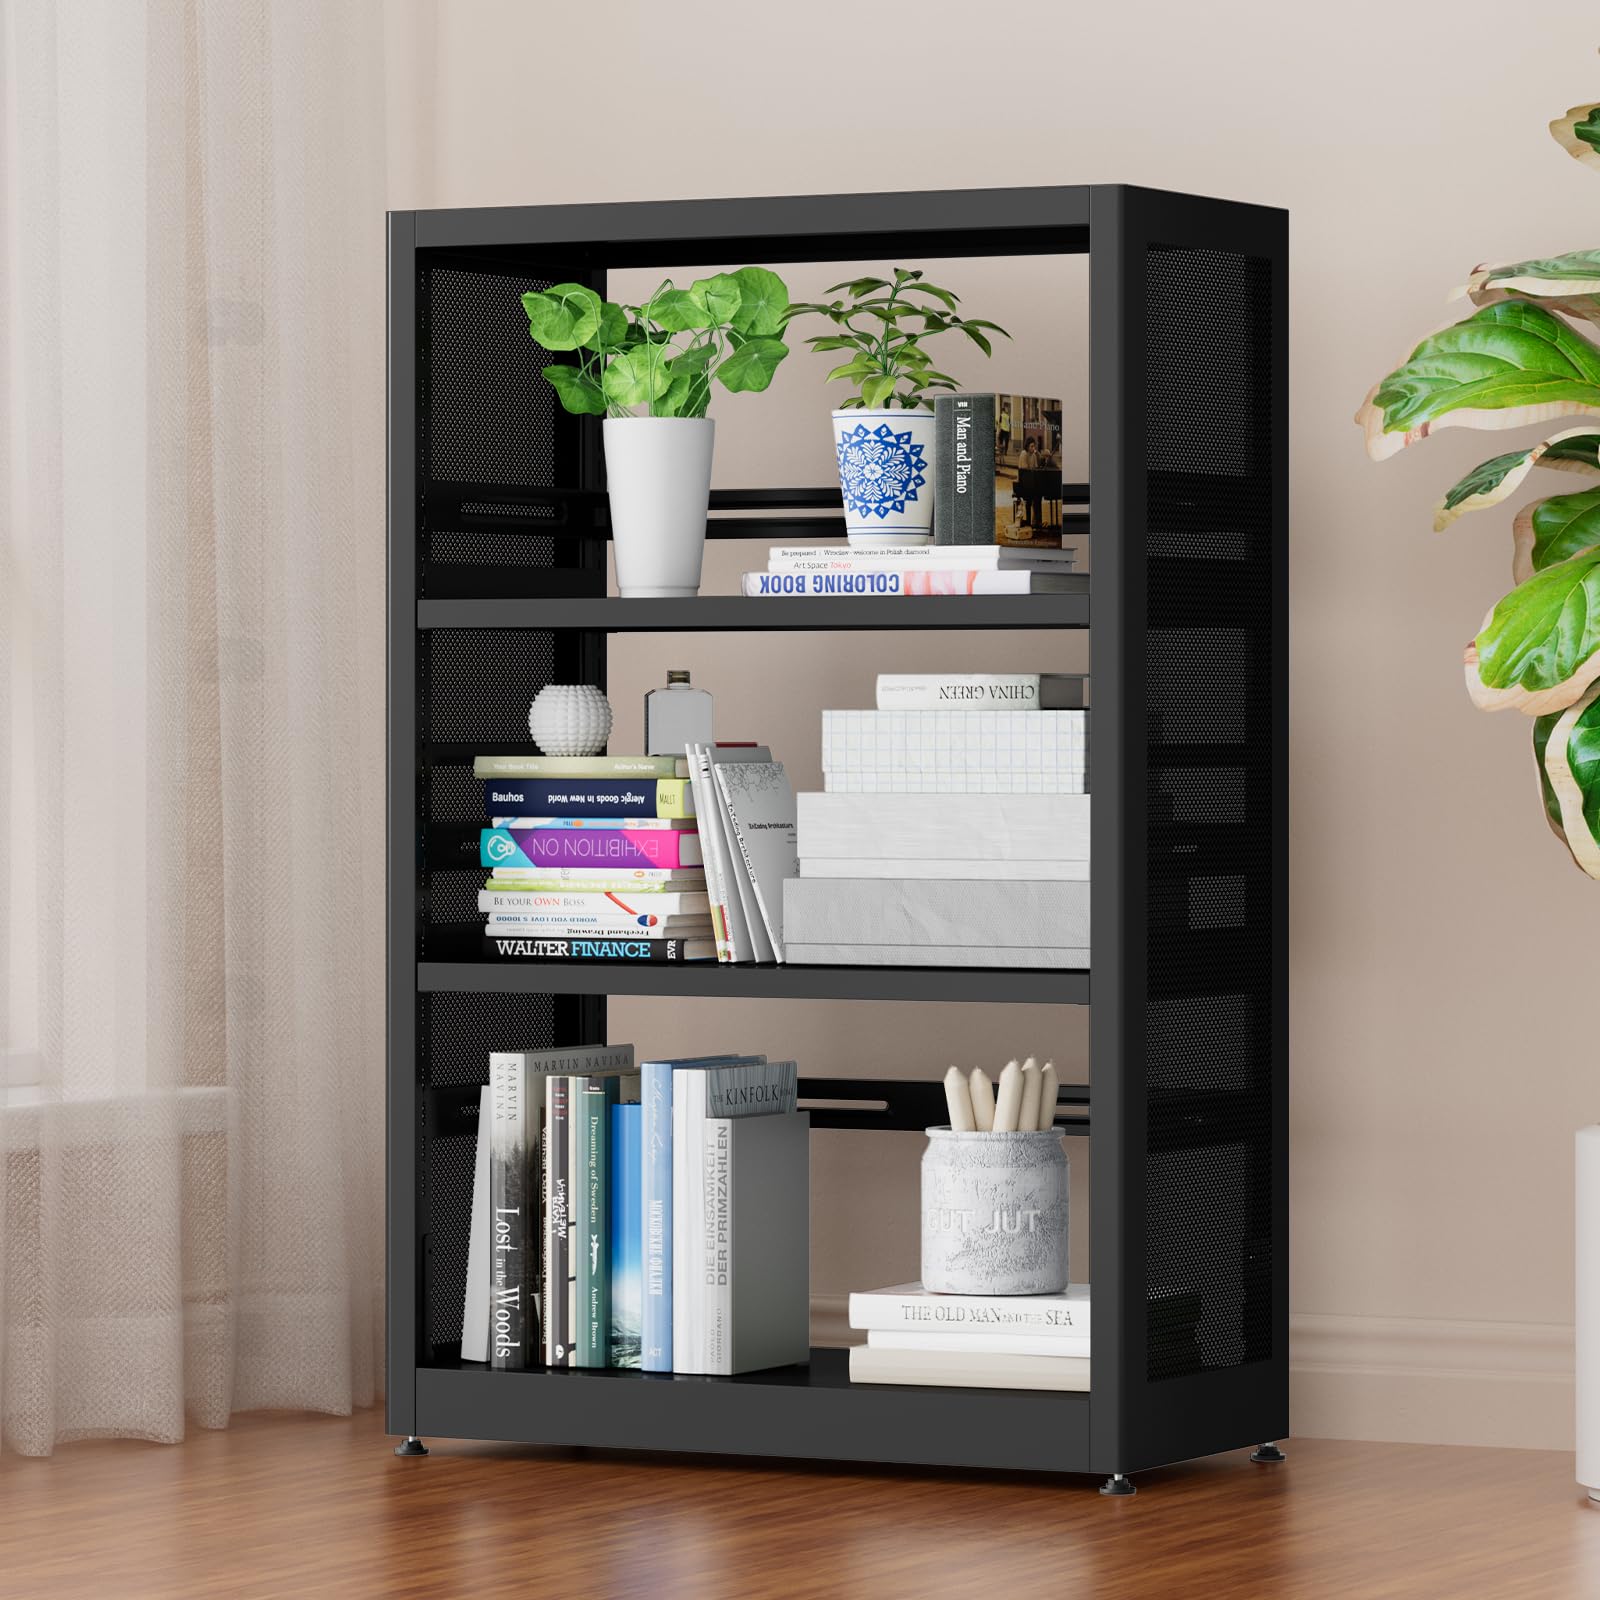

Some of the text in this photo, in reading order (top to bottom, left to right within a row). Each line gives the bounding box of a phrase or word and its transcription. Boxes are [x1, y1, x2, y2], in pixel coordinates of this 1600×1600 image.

[956, 416, 972, 494] Man and Piano
[807, 562, 828, 570] Space
[830, 562, 852, 570] Tokyo
[759, 574, 900, 594] COLORING BOOK
[938, 685, 985, 700] GREEN
[988, 685, 1036, 700] CHINA
[492, 792, 525, 802] Bauhos
[547, 795, 568, 804] World
[570, 795, 585, 804] New
[596, 795, 619, 804] Goods
[620, 792, 645, 804] Alergic
[532, 837, 659, 858] EXHIBITION ON
[507, 897, 532, 906] YOUR
[533, 897, 560, 906] OWN
[567, 928, 604, 936] Drawing
[607, 928, 650, 936] Freehand
[495, 940, 651, 958] WALTER FINANCE
[666, 940, 677, 959] EVR
[534, 1054, 630, 1073] MARVIN NAVINA
[495, 1062, 505, 1120] NAVINA
[507, 1062, 518, 1121] MARVIN
[725, 1084, 779, 1106] KINFOLK
[589, 1116, 599, 1224] Dreaming of Sweden
[705, 1142, 716, 1286] DIE EINSAMKEIT
[717, 1126, 728, 1286] DER PRIMZAHLEN
[495, 1206, 521, 1358] Lost in the Woods
[591, 1287, 599, 1349] Andrew Brown
[901, 1305, 931, 1321] THE
[935, 1305, 966, 1322] OLD
[968, 1307, 1002, 1324] MAN
[1045, 1309, 1073, 1326] SEA
